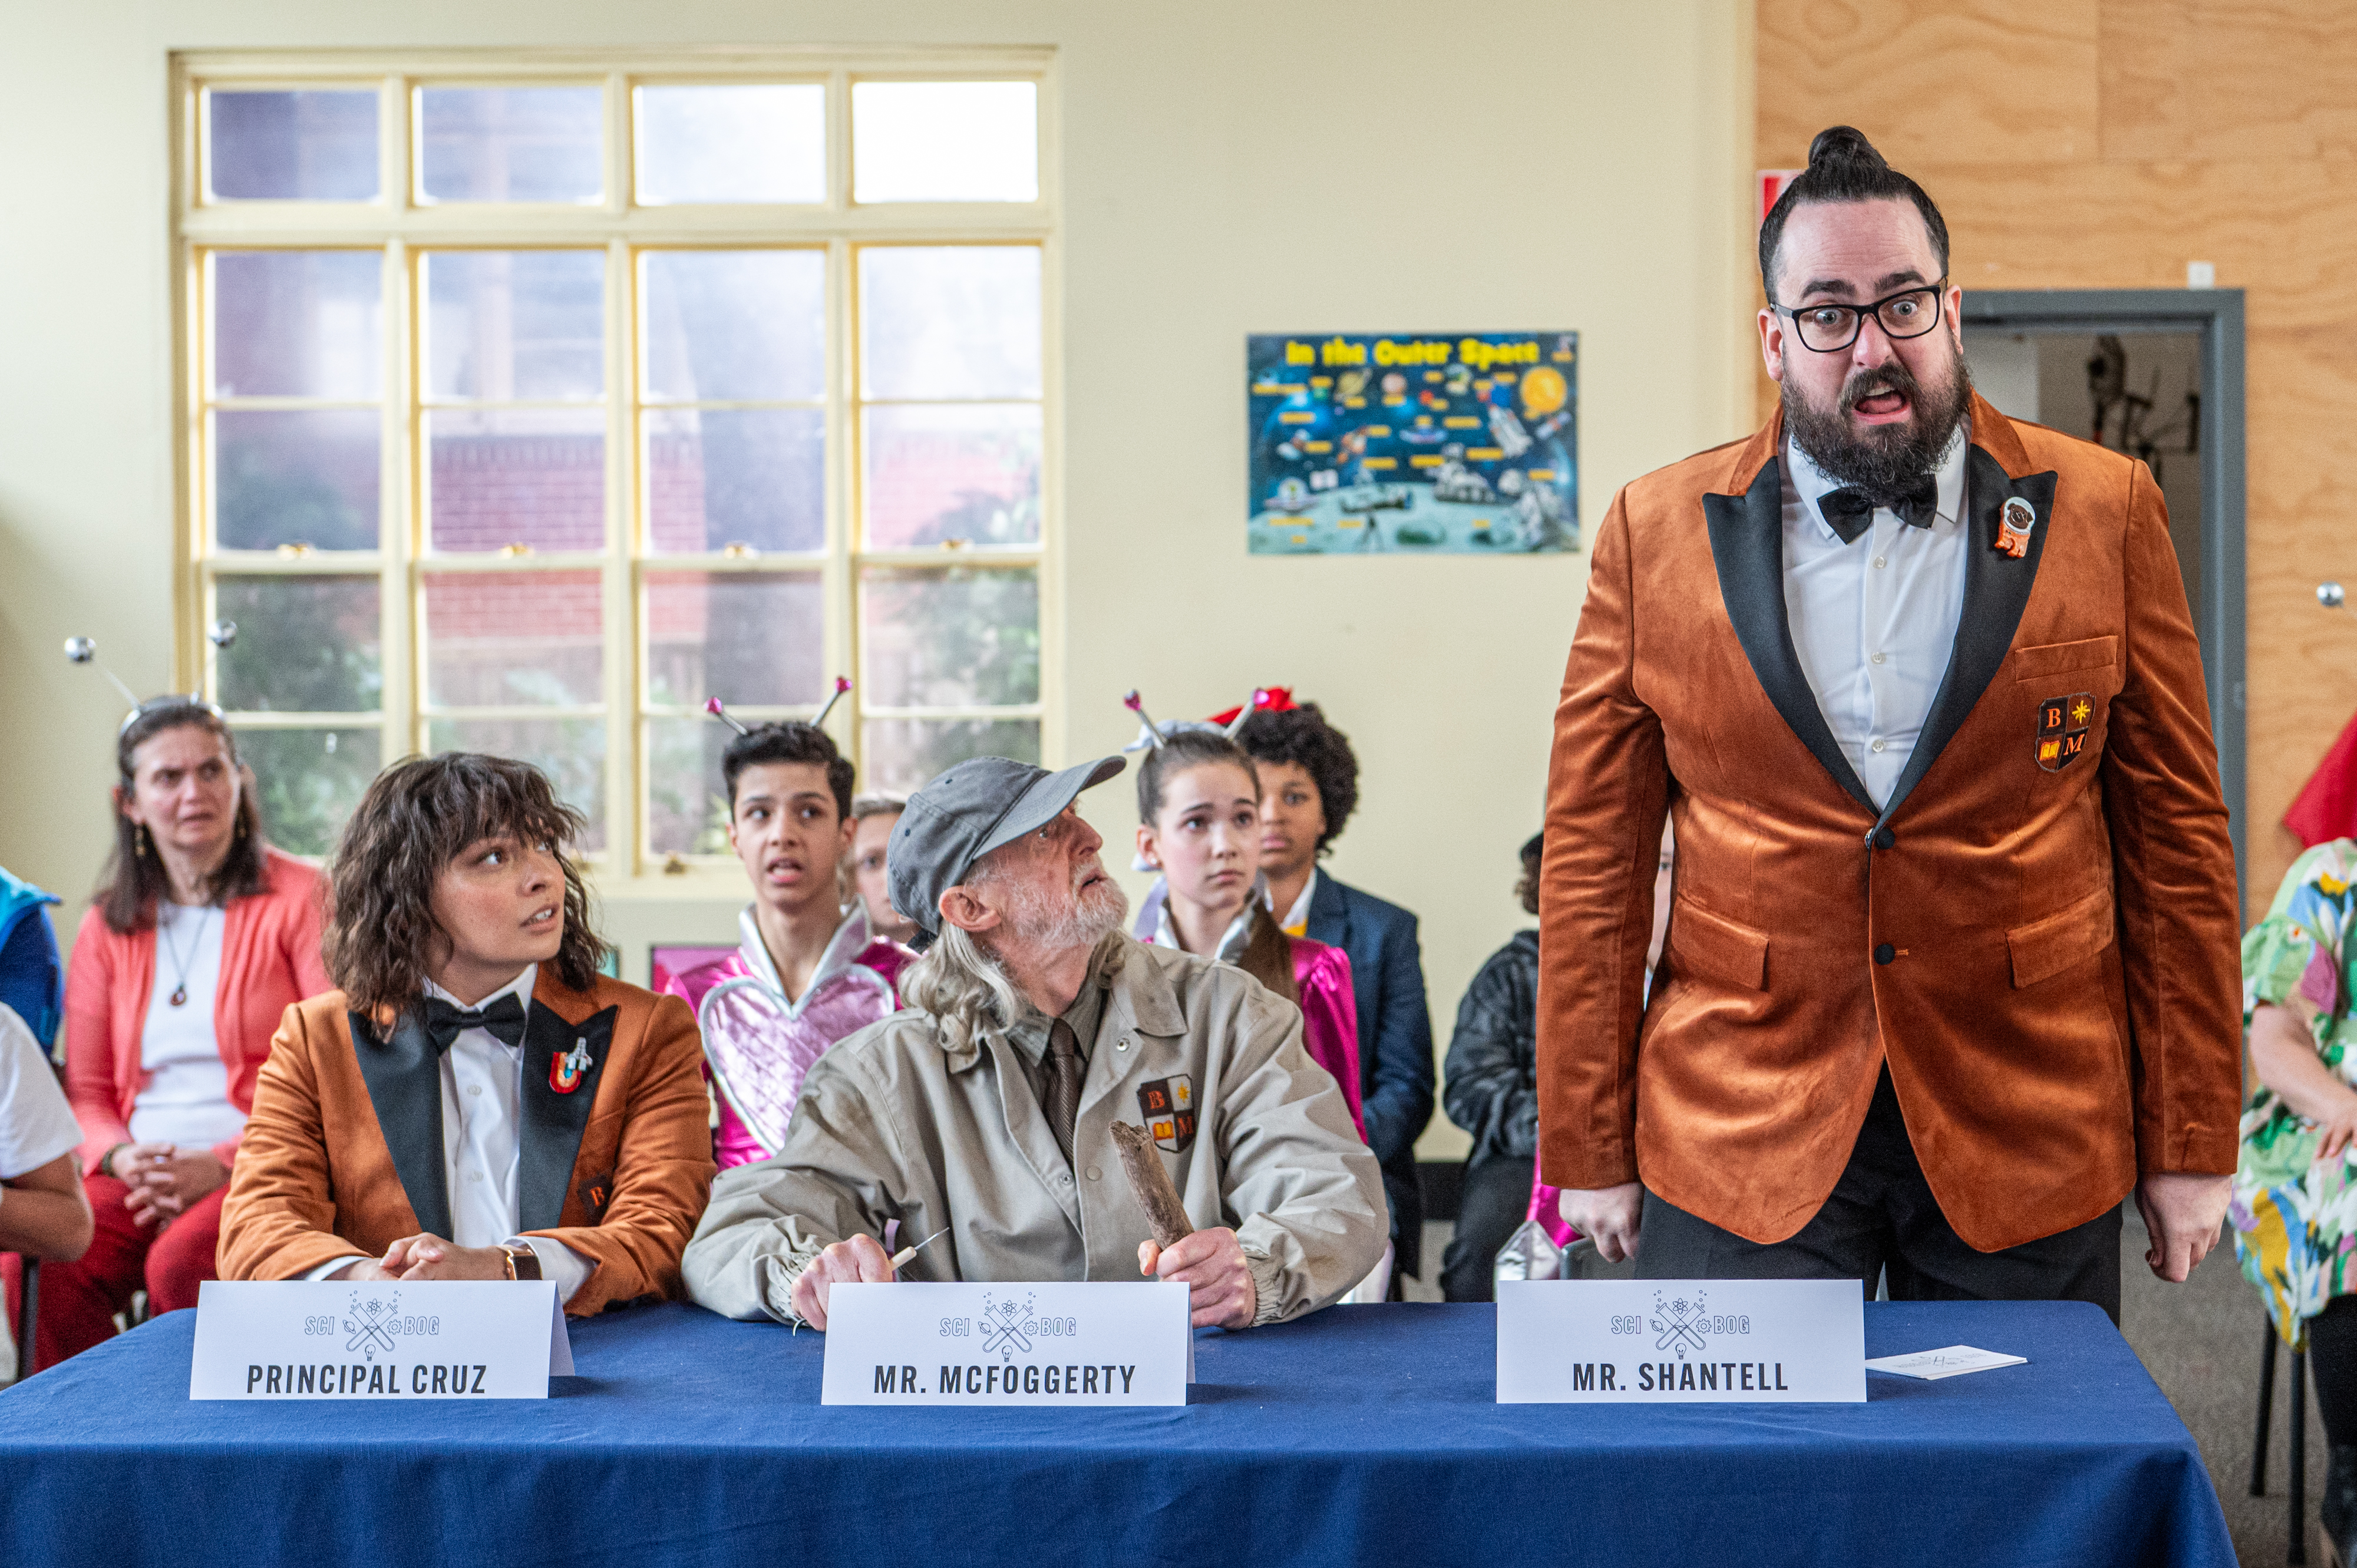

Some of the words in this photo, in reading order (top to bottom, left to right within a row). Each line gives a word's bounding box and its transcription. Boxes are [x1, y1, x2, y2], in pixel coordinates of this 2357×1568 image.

[1458, 339, 1540, 371] Space
[2046, 708, 2061, 728] B
[2064, 734, 2085, 755] M
[1147, 1090, 1166, 1110] B
[589, 1186, 606, 1207] B
[304, 1316, 335, 1335] SCI
[404, 1316, 440, 1335] BOG
[939, 1318, 970, 1337] SCI
[1041, 1317, 1077, 1336] BOG
[1611, 1315, 1642, 1335] SCI
[1714, 1315, 1750, 1335] BOG
[247, 1365, 400, 1394] PRINCIPAL
[412, 1365, 487, 1394] CRUZ
[874, 1365, 926, 1394] MR.
[940, 1365, 1135, 1394] MCFOGGERTY
[1573, 1363, 1626, 1391] MR.
[1638, 1363, 1788, 1391] SHANTELL
